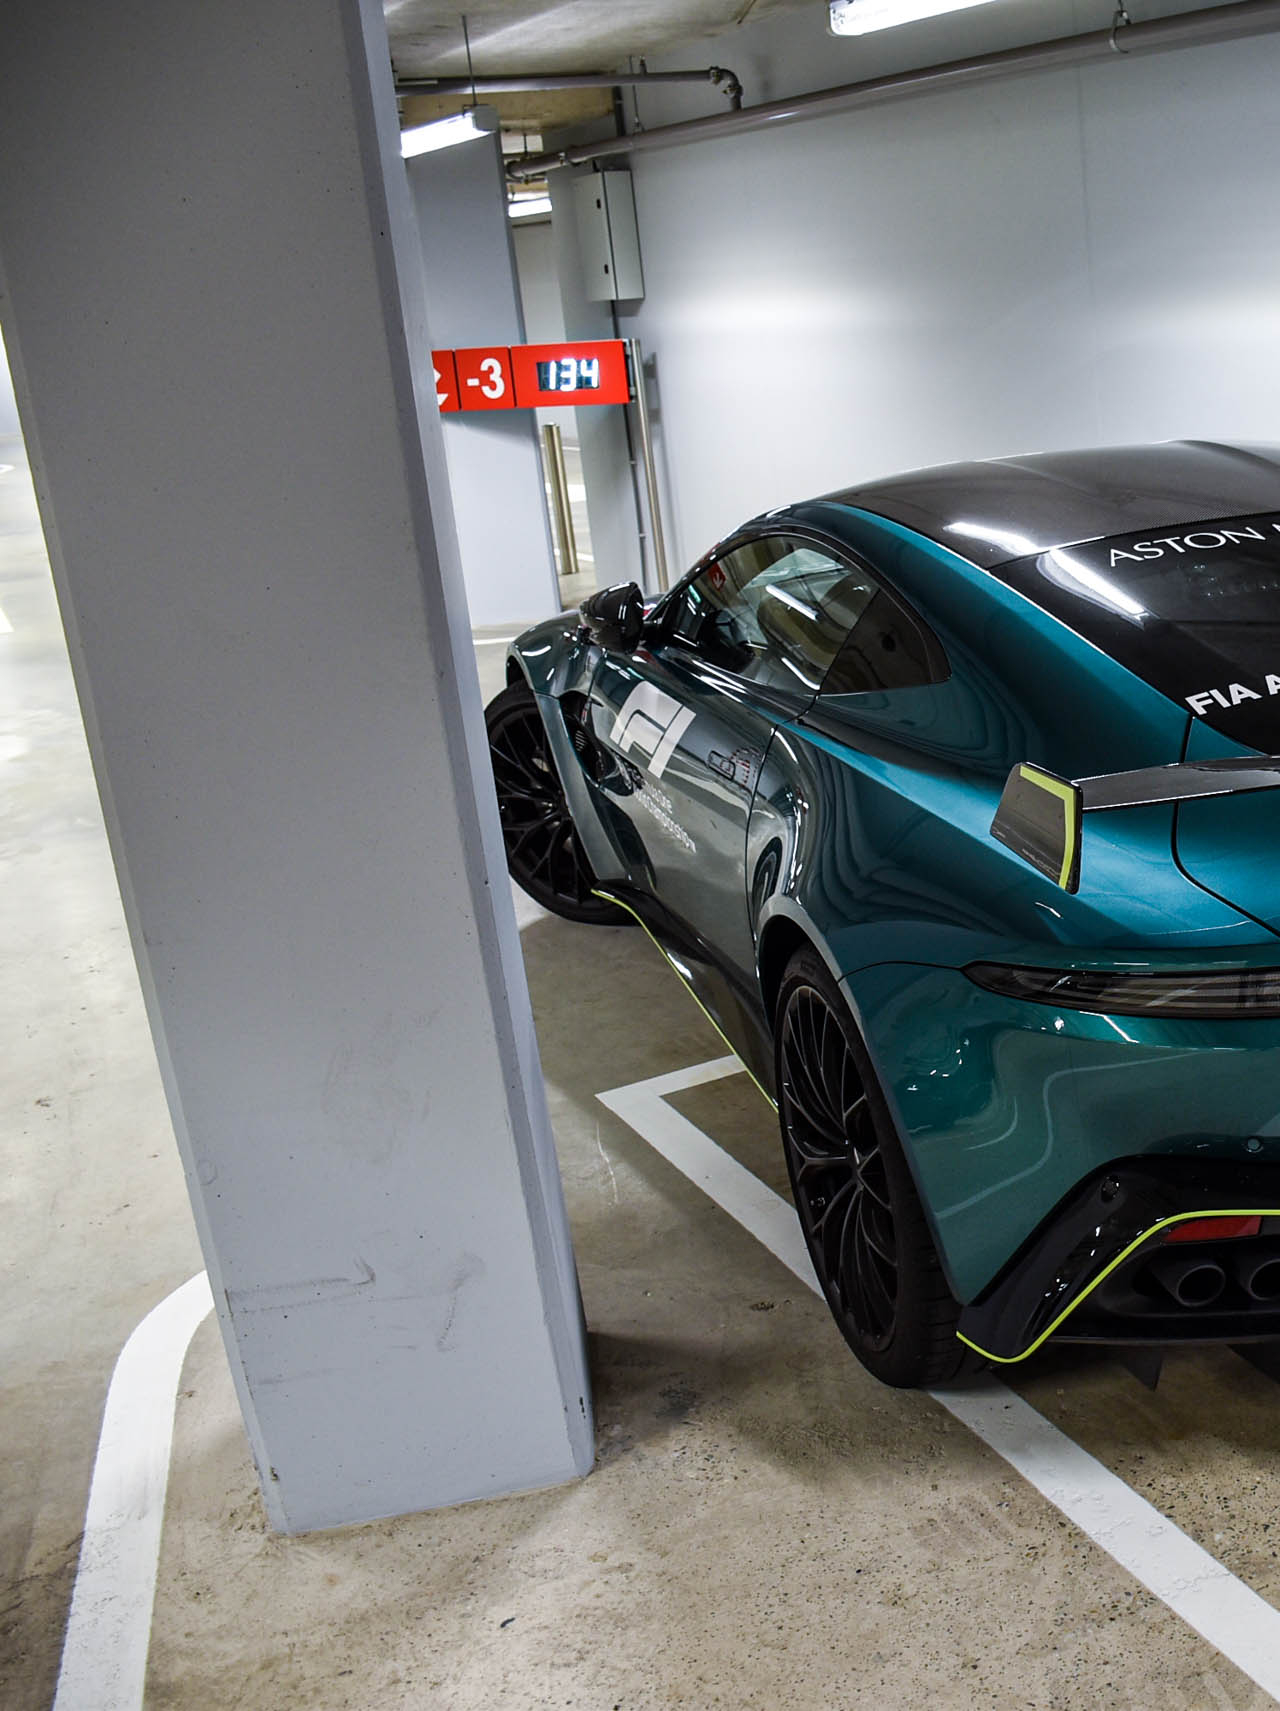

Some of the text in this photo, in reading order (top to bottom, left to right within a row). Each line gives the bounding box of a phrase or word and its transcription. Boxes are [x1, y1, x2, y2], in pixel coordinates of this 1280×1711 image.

[466, 358, 505, 399] -3
[548, 358, 599, 391] 134
[1110, 526, 1266, 567] ASTON
[1185, 683, 1262, 715] FIA
